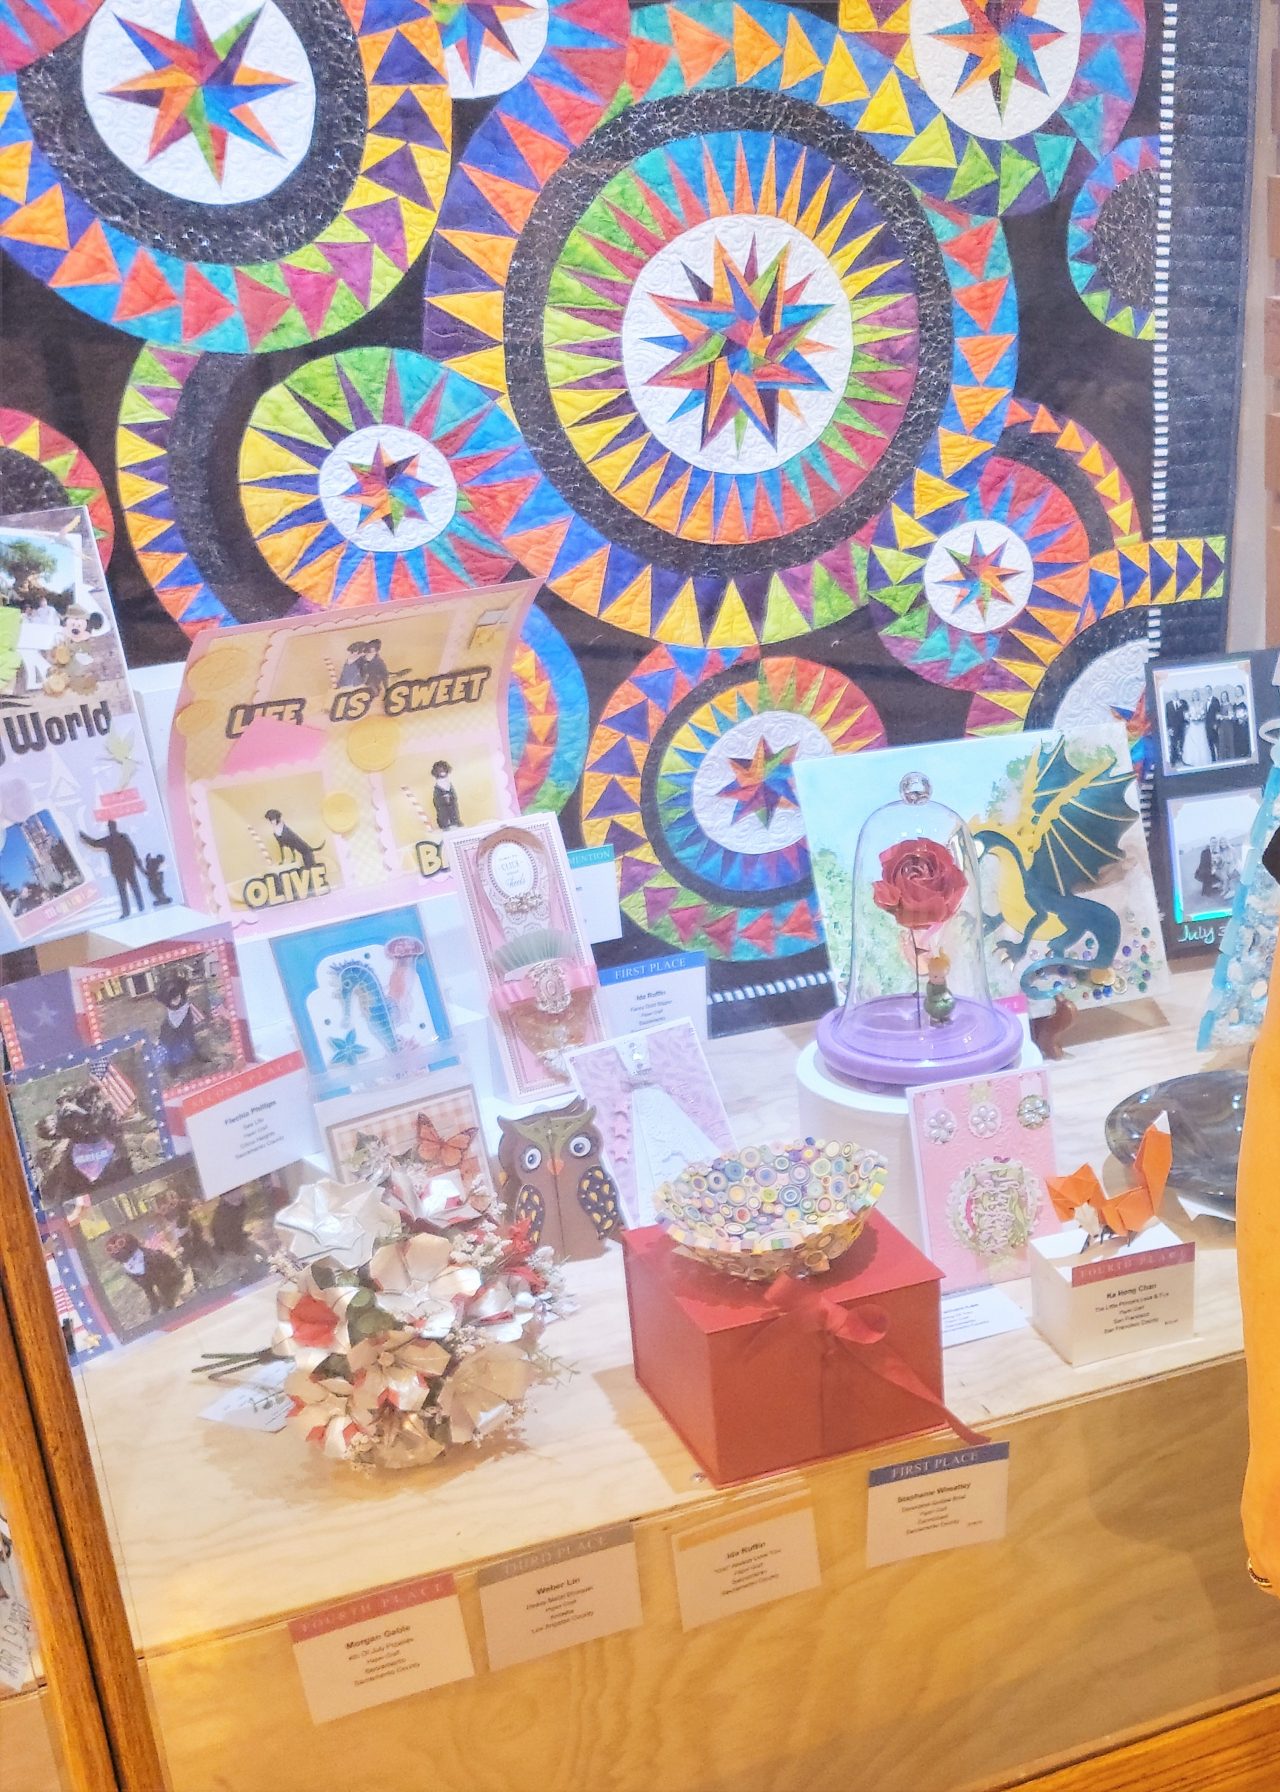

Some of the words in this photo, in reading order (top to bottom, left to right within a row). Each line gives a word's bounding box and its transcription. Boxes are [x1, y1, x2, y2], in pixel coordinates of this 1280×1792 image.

[330, 688, 371, 722] IS
[385, 667, 492, 717] SWEET
[4, 700, 112, 755] World
[244, 863, 331, 910] OLIVE
[1178, 924, 1215, 945] July
[615, 965, 646, 980] FIRST
[650, 958, 687, 973] PLACE
[891, 1461, 930, 1479] FIRST
[934, 1451, 979, 1469] PLACE
[344, 1634, 382, 1651] Morgan
